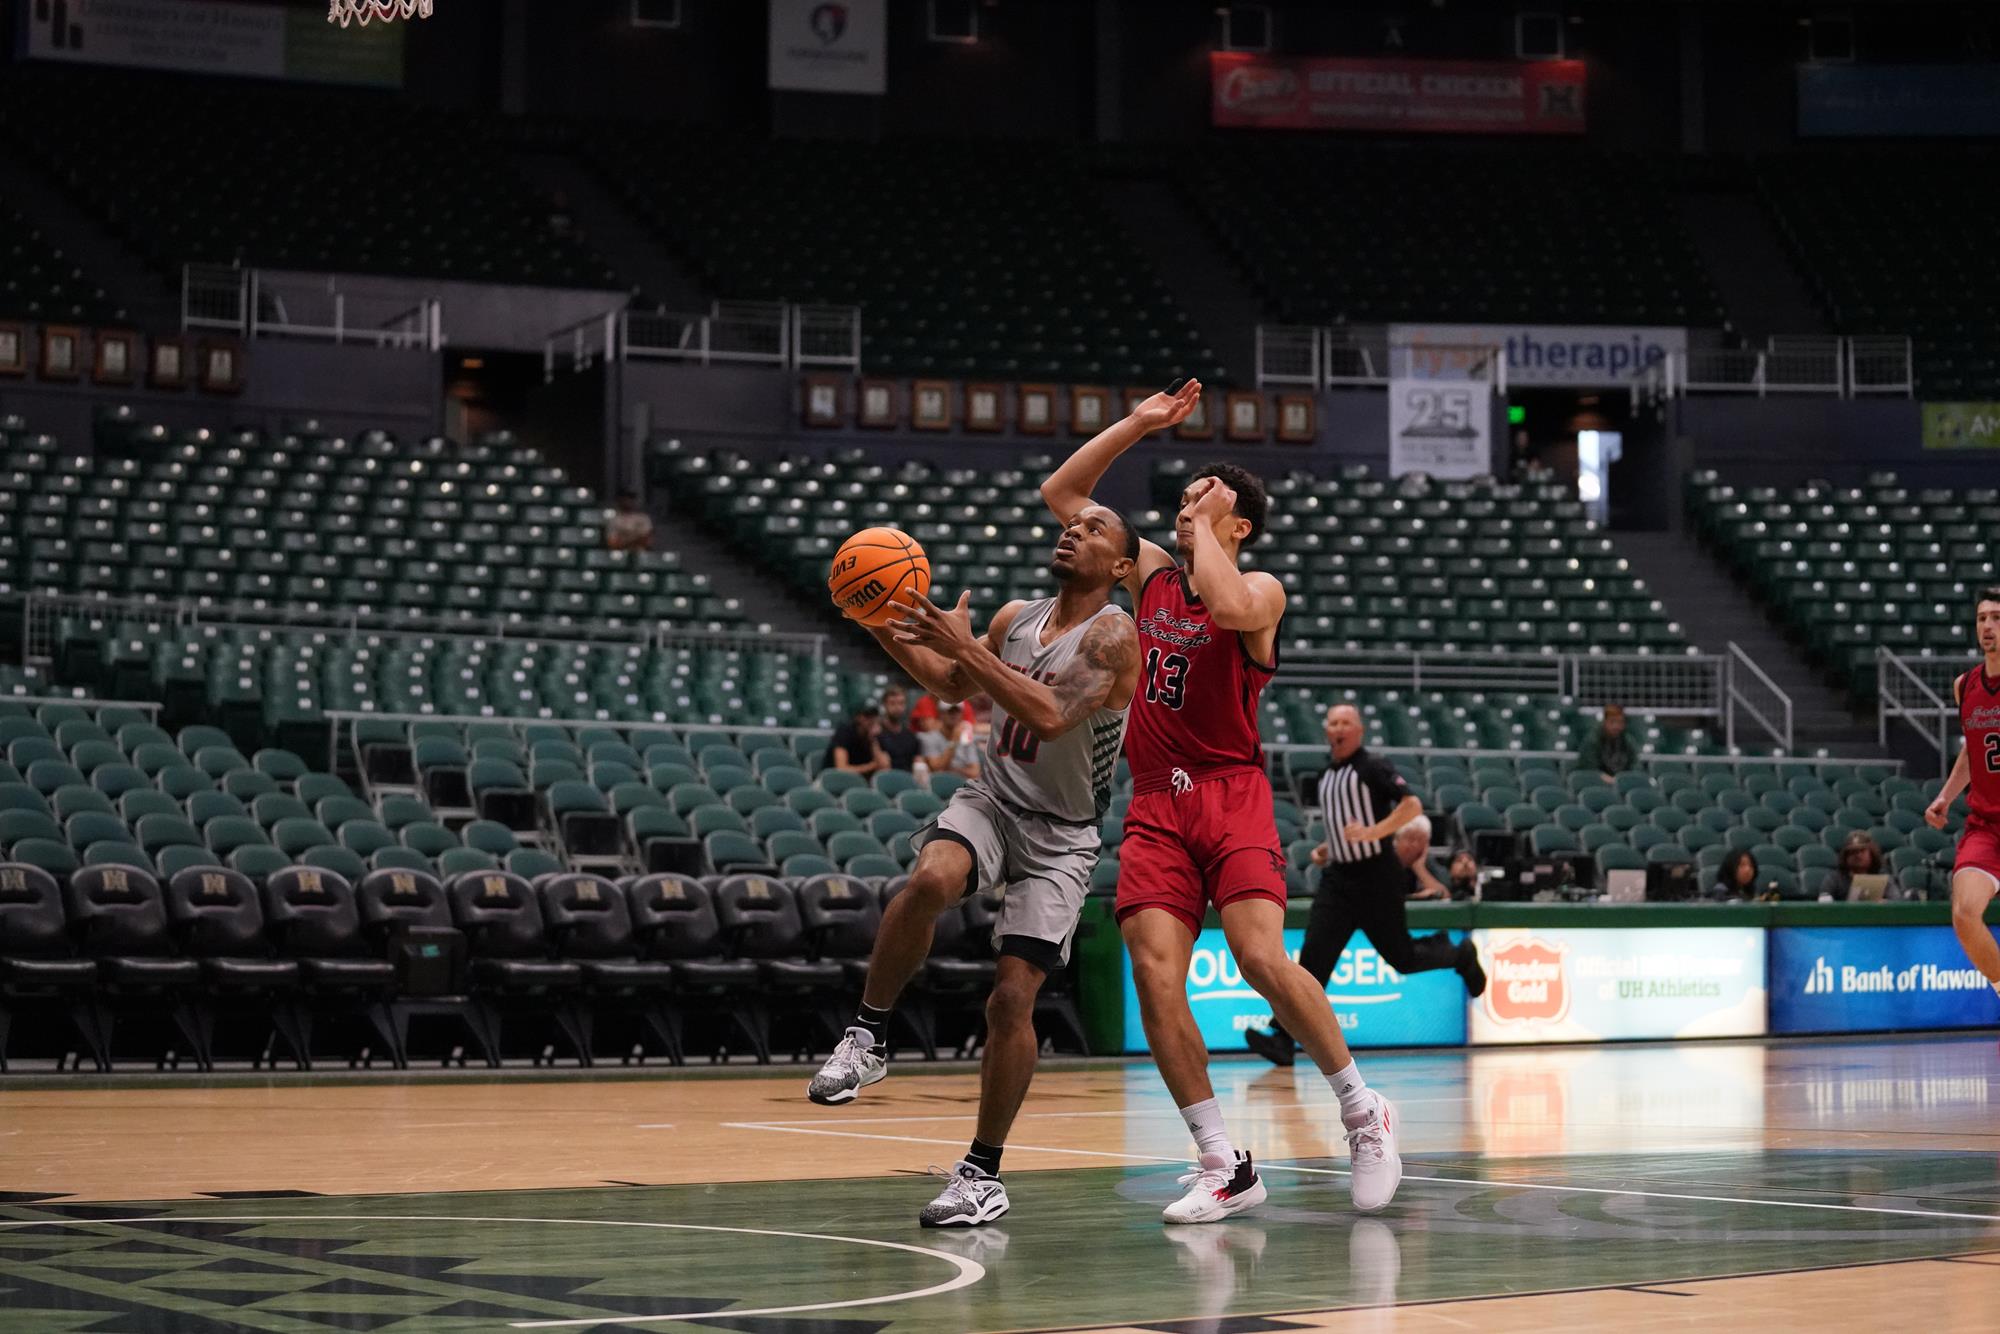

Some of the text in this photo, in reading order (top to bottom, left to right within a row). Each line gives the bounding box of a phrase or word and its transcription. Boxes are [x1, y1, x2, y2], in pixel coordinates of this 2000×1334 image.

[1145, 646, 1191, 711] 13
[1494, 959, 1560, 982] Meadow
[1841, 964, 1894, 993] Bank
[1897, 963, 1920, 993] of
[1507, 980, 1549, 1003] Gold
[1618, 979, 1645, 999] UH
[1647, 977, 1722, 998] Athletics
